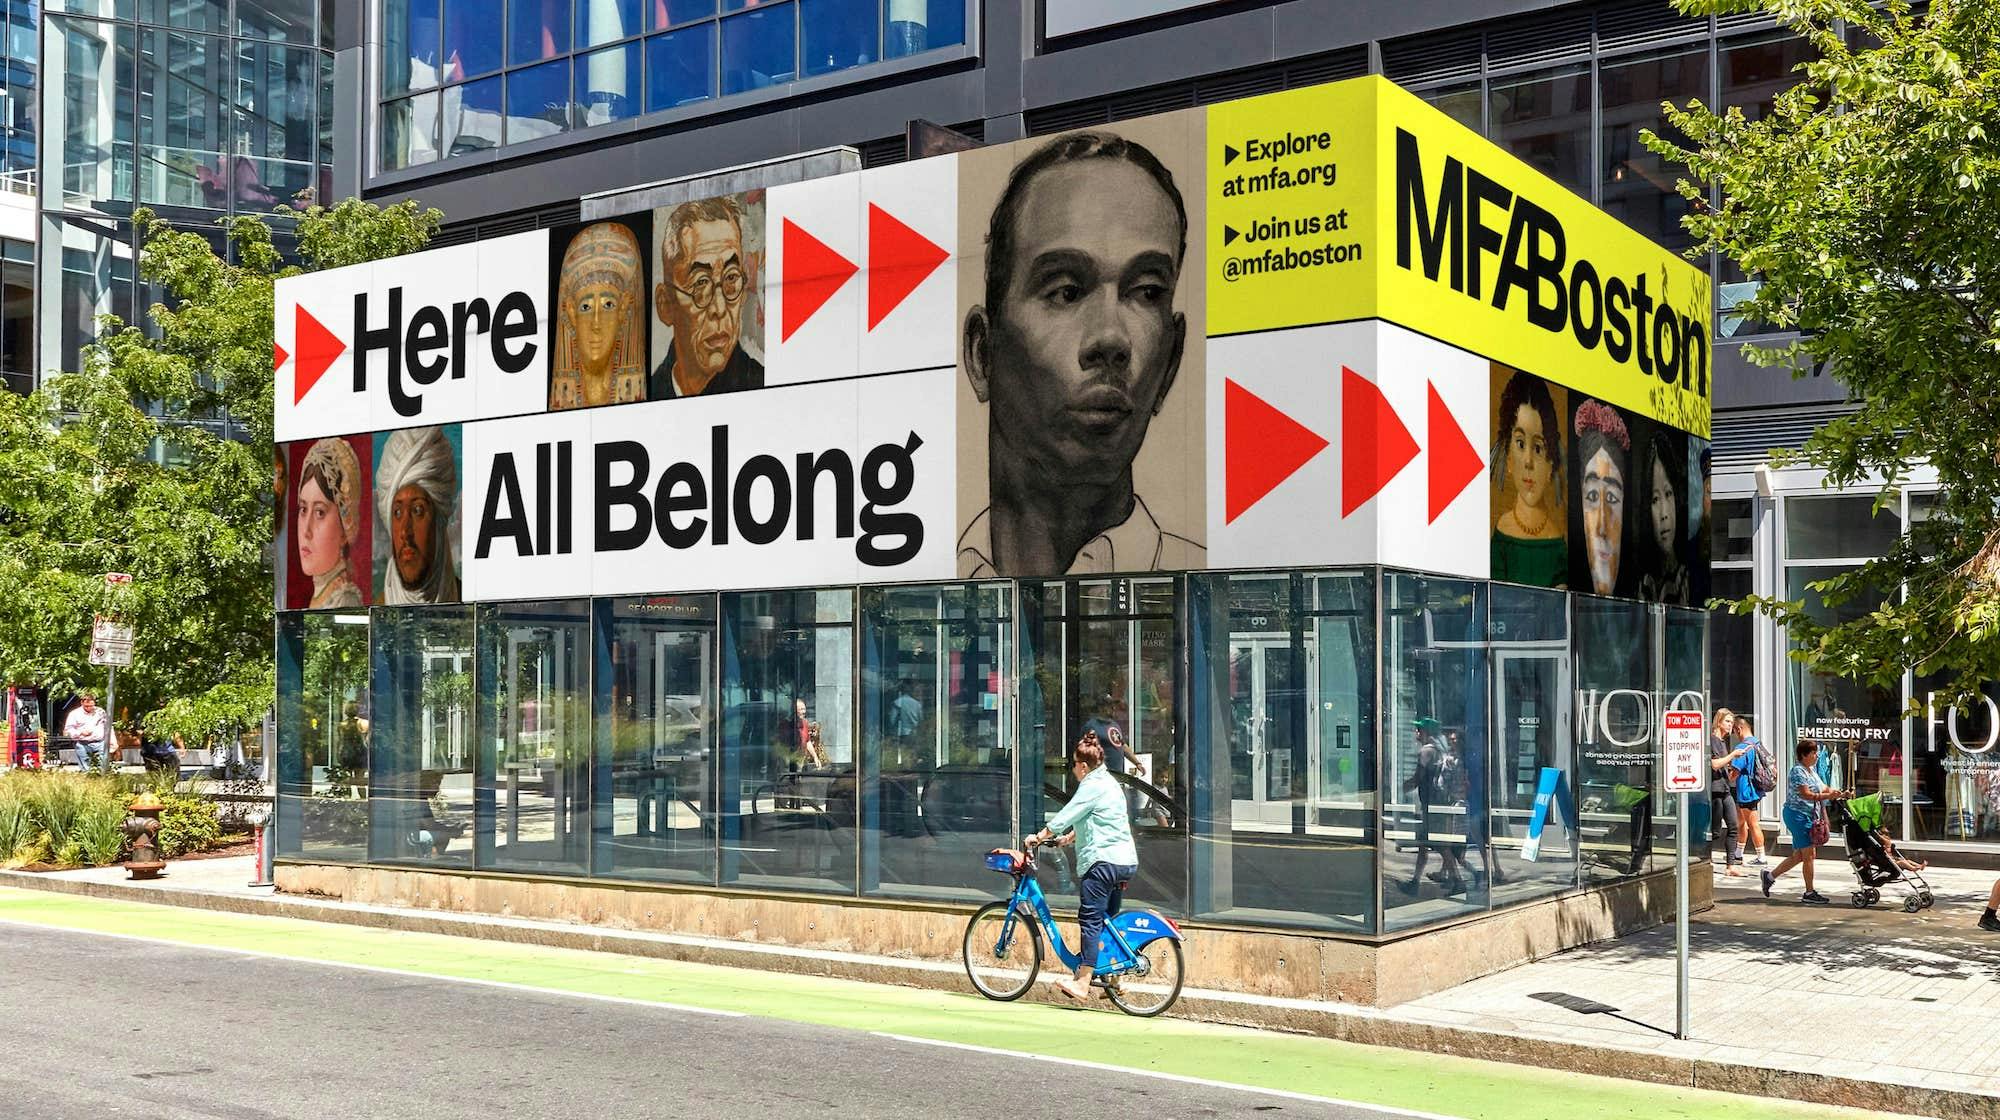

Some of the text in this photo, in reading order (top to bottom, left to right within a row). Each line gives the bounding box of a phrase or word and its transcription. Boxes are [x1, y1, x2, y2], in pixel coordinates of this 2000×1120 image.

[1246, 132, 1331, 162] Explore
[1223, 163, 1336, 197] at mfa.org
[1245, 208, 1348, 243] Join us at
[1223, 243, 1362, 282] @mfaboston
[1396, 126, 1706, 398] MFABoston
[353, 286, 538, 417] Here
[475, 424, 924, 567] All Belong
[1667, 715, 1701, 725] TOW ZONE
[1833, 717, 1870, 726] featuring
[1680, 730, 1689, 739] NO
[1797, 727, 1891, 740] EMERSON FRY
[1668, 742, 1700, 751] STOPPING
[1677, 753, 1692, 762] ANY
[1677, 765, 1692, 774] TIME
